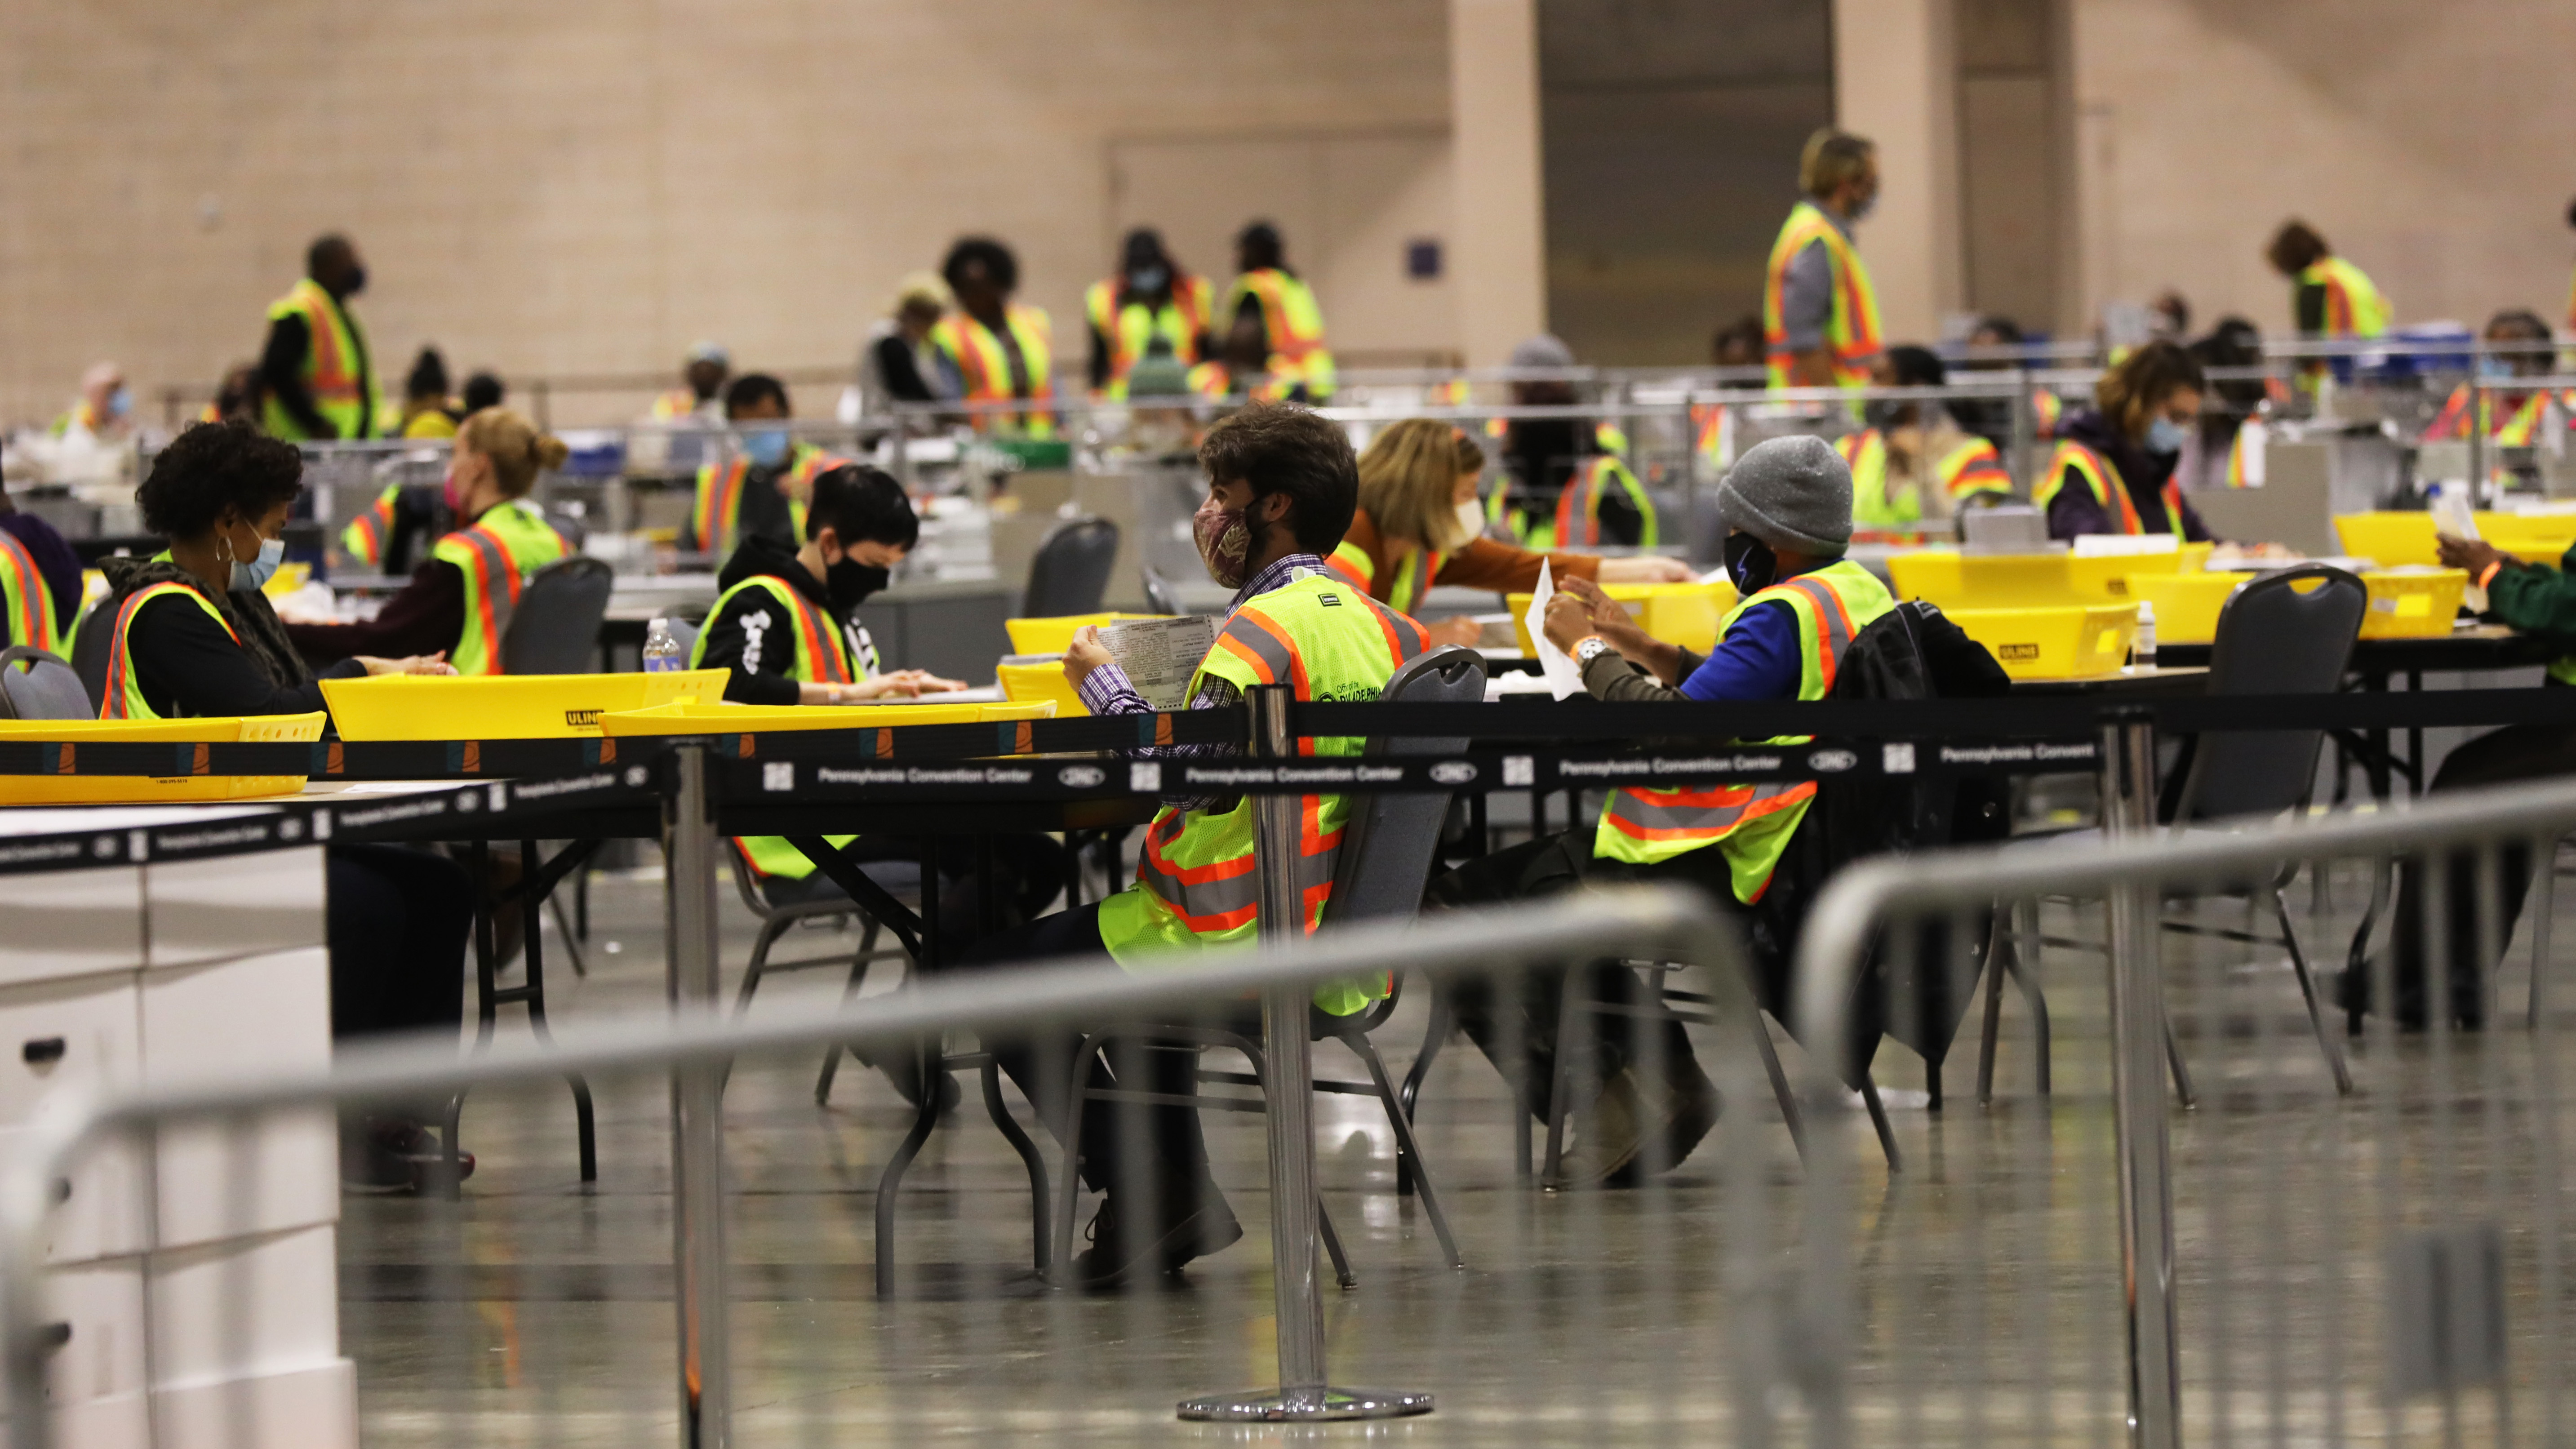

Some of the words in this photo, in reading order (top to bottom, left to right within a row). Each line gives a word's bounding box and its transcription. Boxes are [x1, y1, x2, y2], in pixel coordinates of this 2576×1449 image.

[566, 711, 598, 724] ULIN
[1940, 747, 2032, 763] Pennsylvania
[2034, 743, 2094, 760] Convent
[1186, 768, 1274, 784] Pennsylvania
[1276, 767, 1354, 782] Convention
[1356, 766, 1403, 781] Center
[1559, 760, 1649, 776] Pennsylvania
[1652, 758, 1731, 773] Convention
[1733, 756, 1781, 770] Center
[818, 768, 905, 784] Pennsylvania
[907, 768, 983, 782] Convention
[986, 768, 1031, 782] Center
